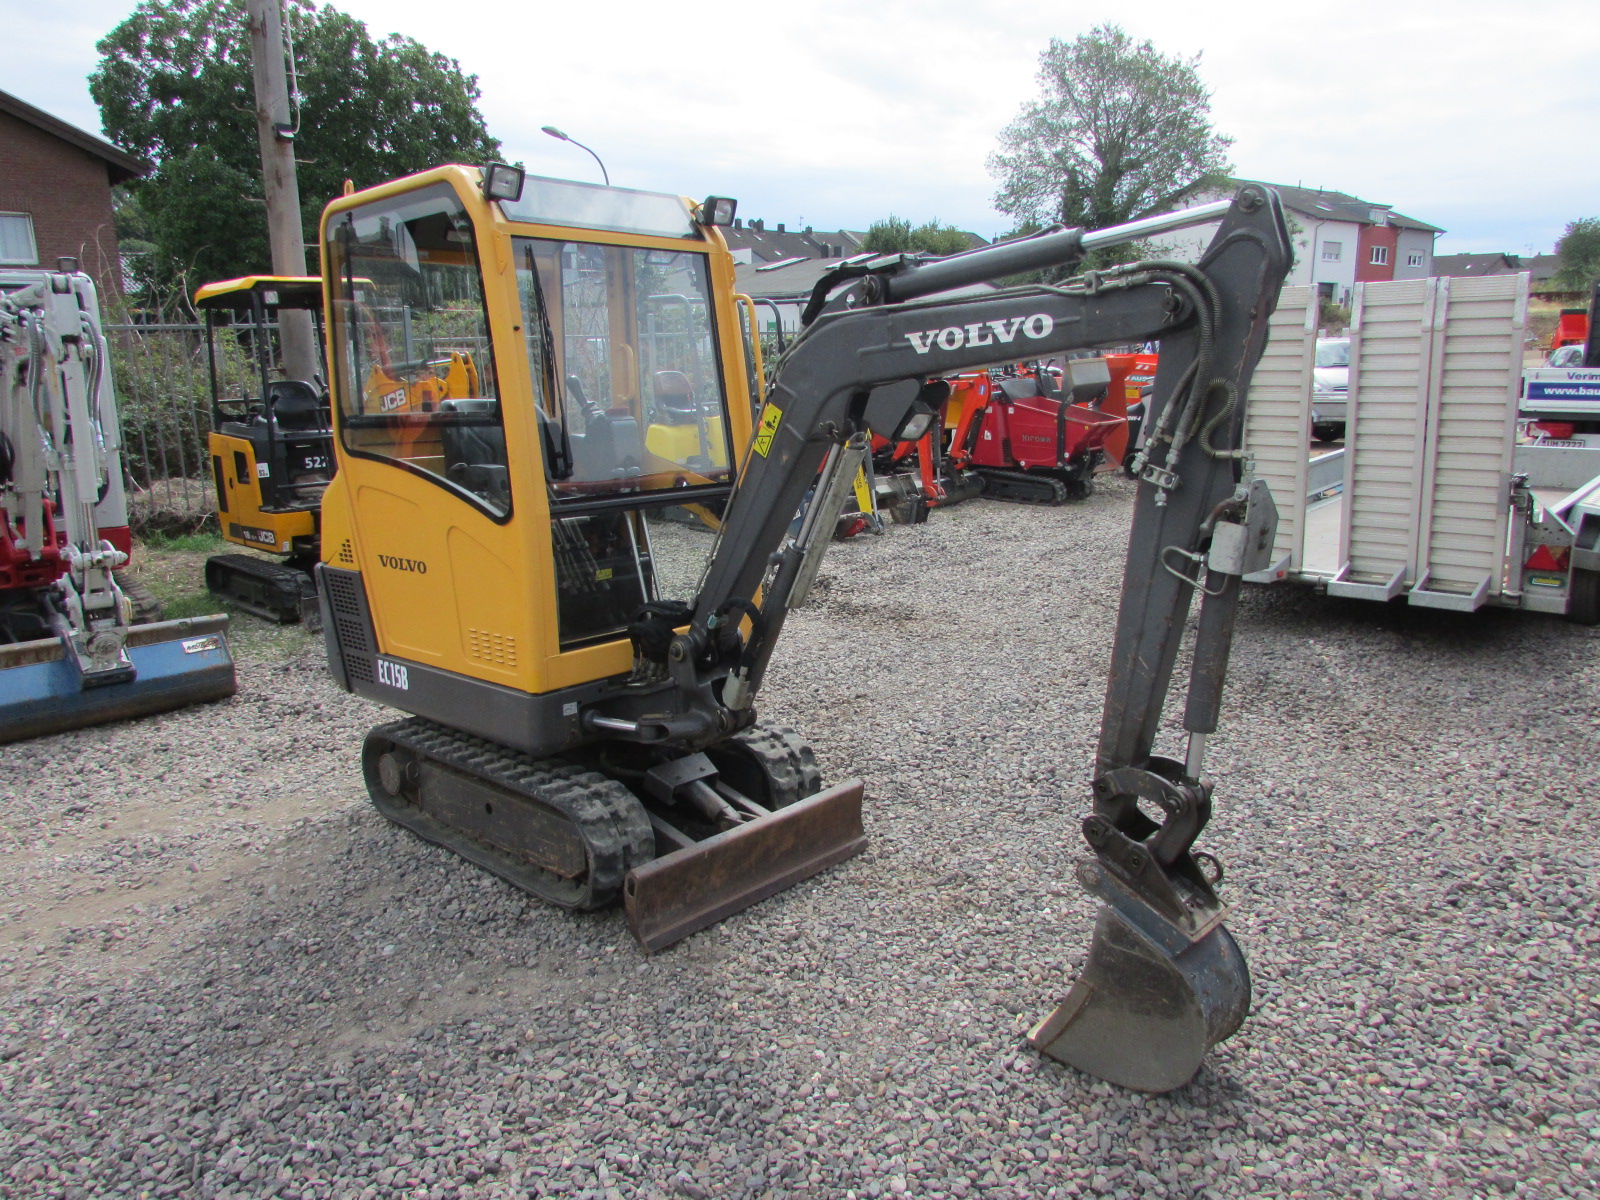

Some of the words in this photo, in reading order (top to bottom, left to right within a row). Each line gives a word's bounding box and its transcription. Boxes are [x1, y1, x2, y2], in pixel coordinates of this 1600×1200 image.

[905, 314, 1054, 354] VOLVO
[381, 388, 407, 412] JCB
[258, 530, 276, 544] JCB
[377, 554, 428, 575] VOLVO
[377, 659, 409, 691] EC15B
